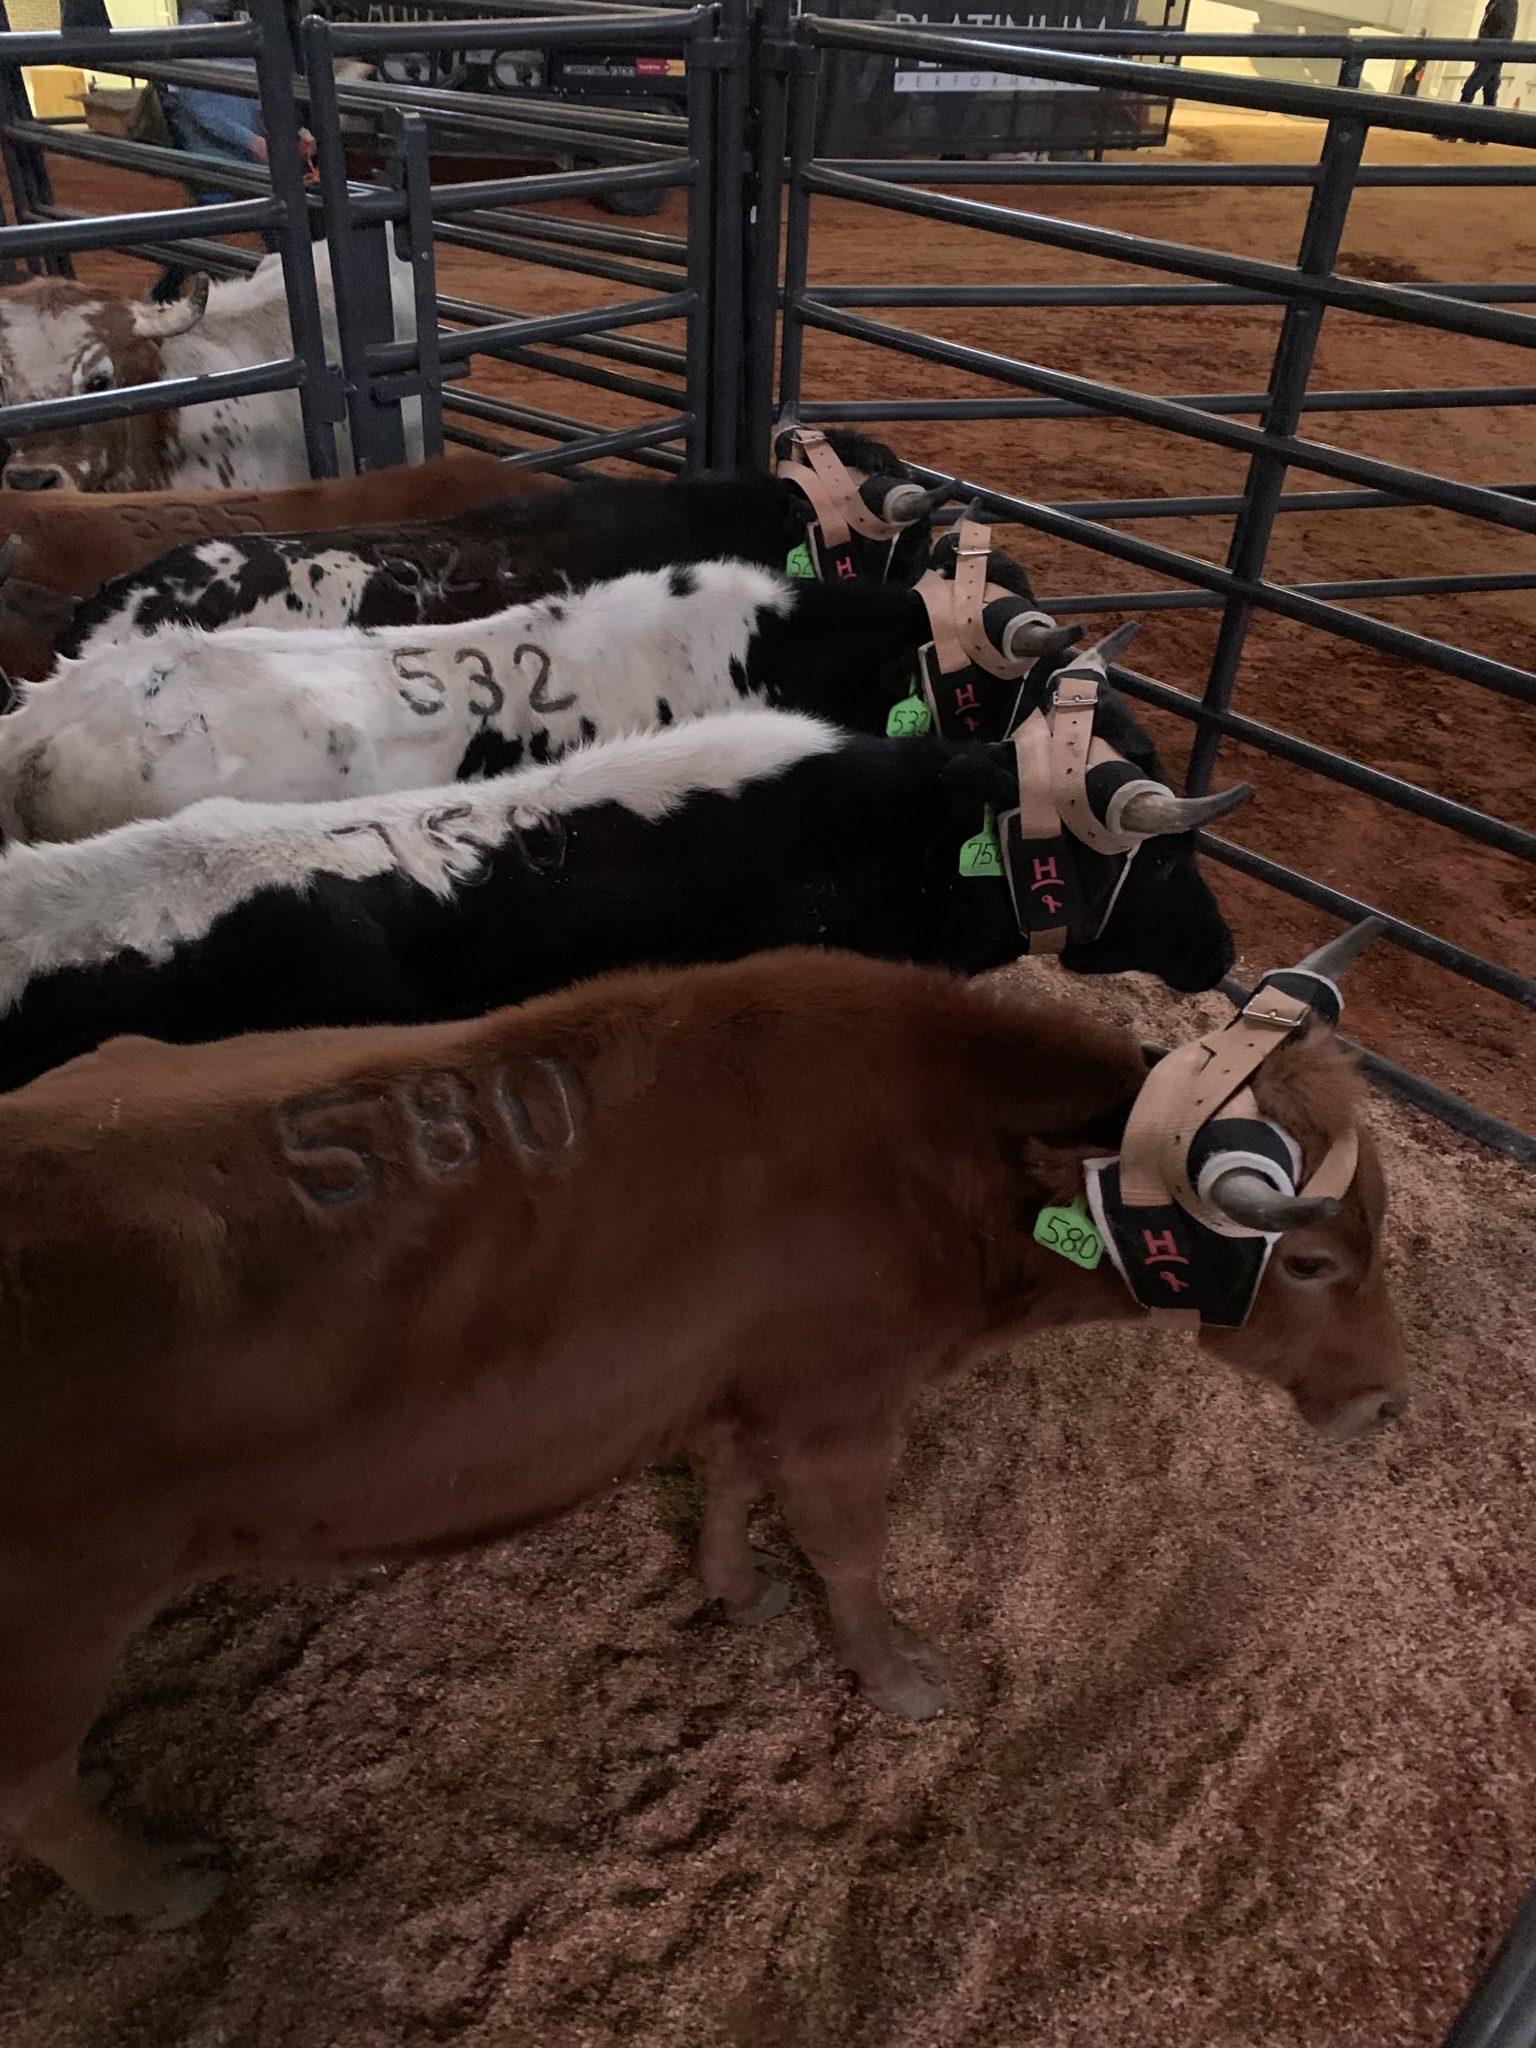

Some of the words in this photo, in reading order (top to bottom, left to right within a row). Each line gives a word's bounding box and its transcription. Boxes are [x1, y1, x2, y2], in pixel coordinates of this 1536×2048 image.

[897, 74, 1076, 88] PERFORMAN
[791, 553, 812, 575] 52
[390, 643, 576, 715] 532
[954, 683, 976, 707] H
[893, 710, 930, 735] 532
[324, 801, 568, 887] 750
[1032, 855, 1058, 881] H
[276, 1055, 584, 1208] 580
[1040, 1215, 1099, 1260] 580
[1142, 1229, 1179, 1256] H
